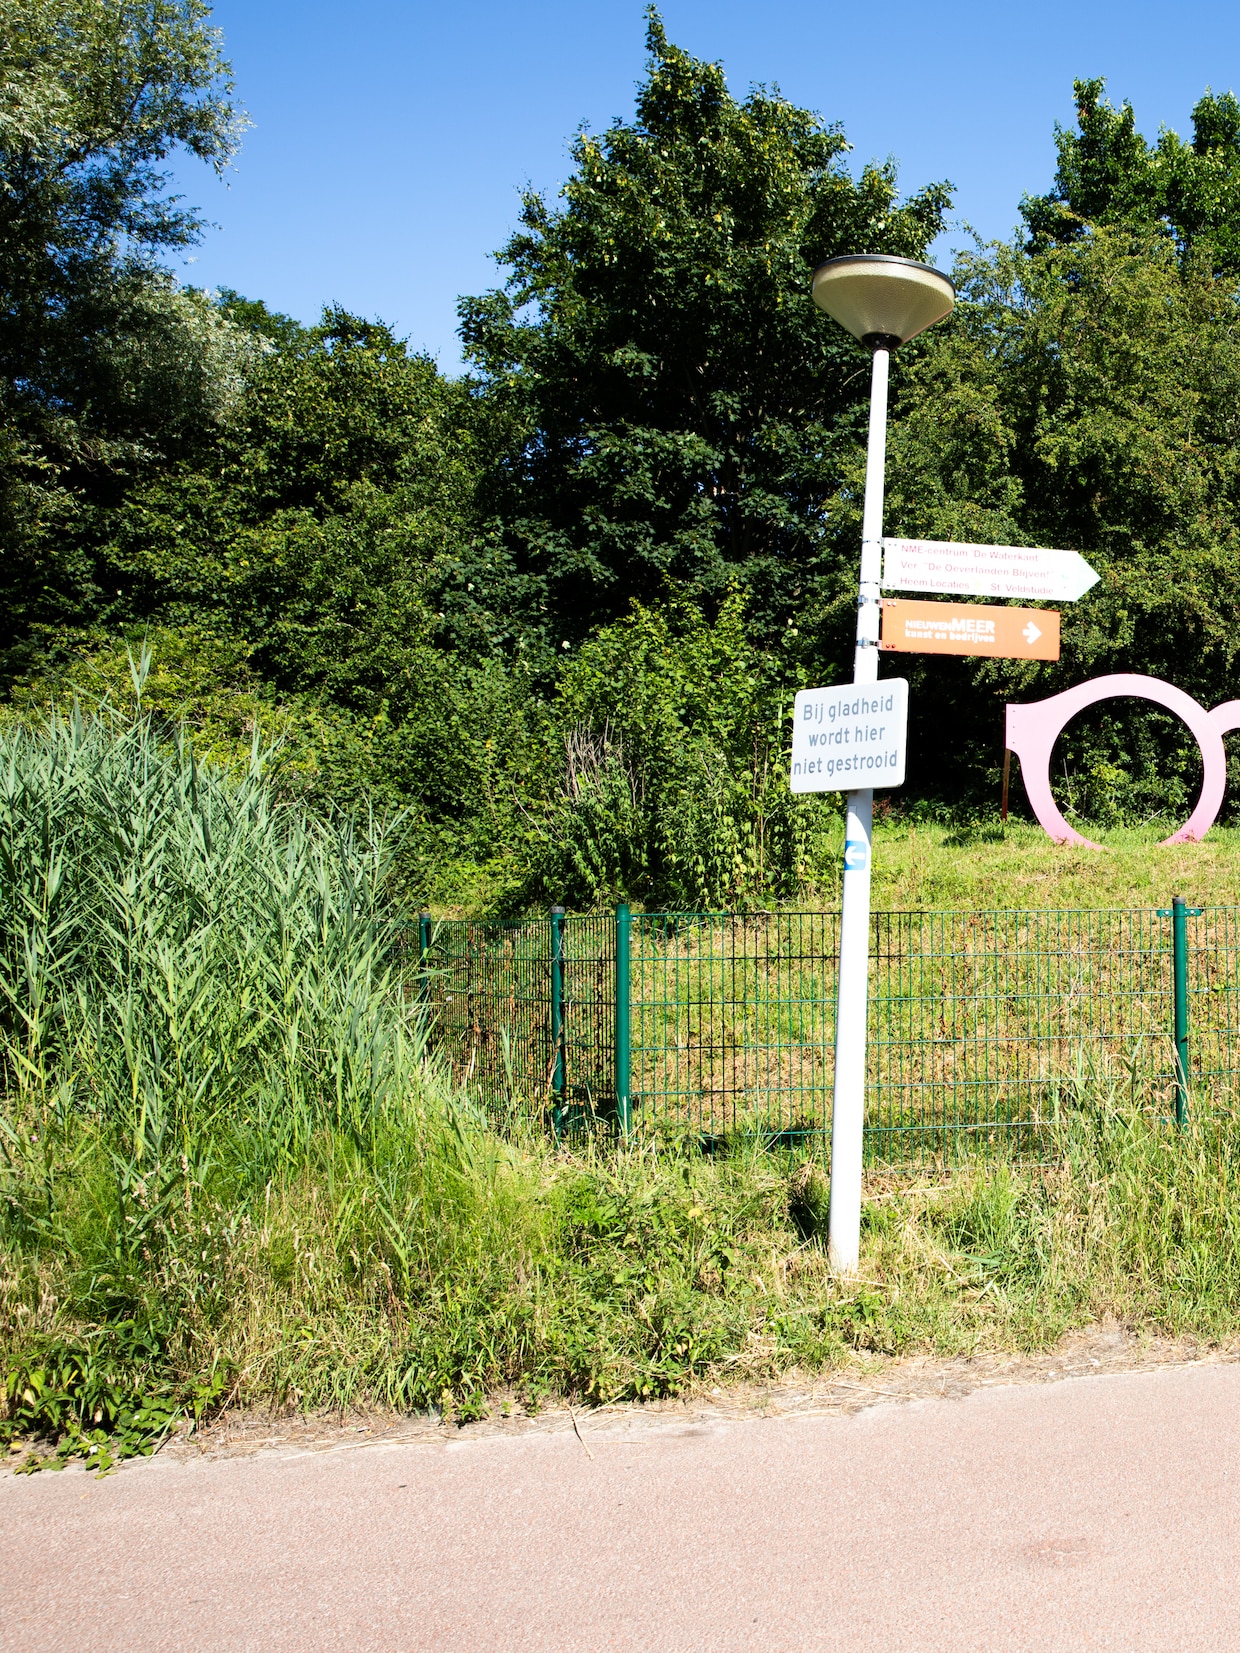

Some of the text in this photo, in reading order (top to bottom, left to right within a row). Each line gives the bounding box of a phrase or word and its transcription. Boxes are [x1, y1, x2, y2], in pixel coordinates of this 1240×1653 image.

[901, 545, 968, 557] NME-centrum
[944, 563, 1009, 576] Oeverlanden
[900, 577, 970, 589] Heem Locaties
[1005, 583, 1054, 595] Veldstudie
[904, 629, 995, 644] kunst en bedrijven
[803, 694, 894, 725] Bij gladheid
[808, 725, 886, 747] wordt hier
[793, 750, 898, 777] niet gestrooid
